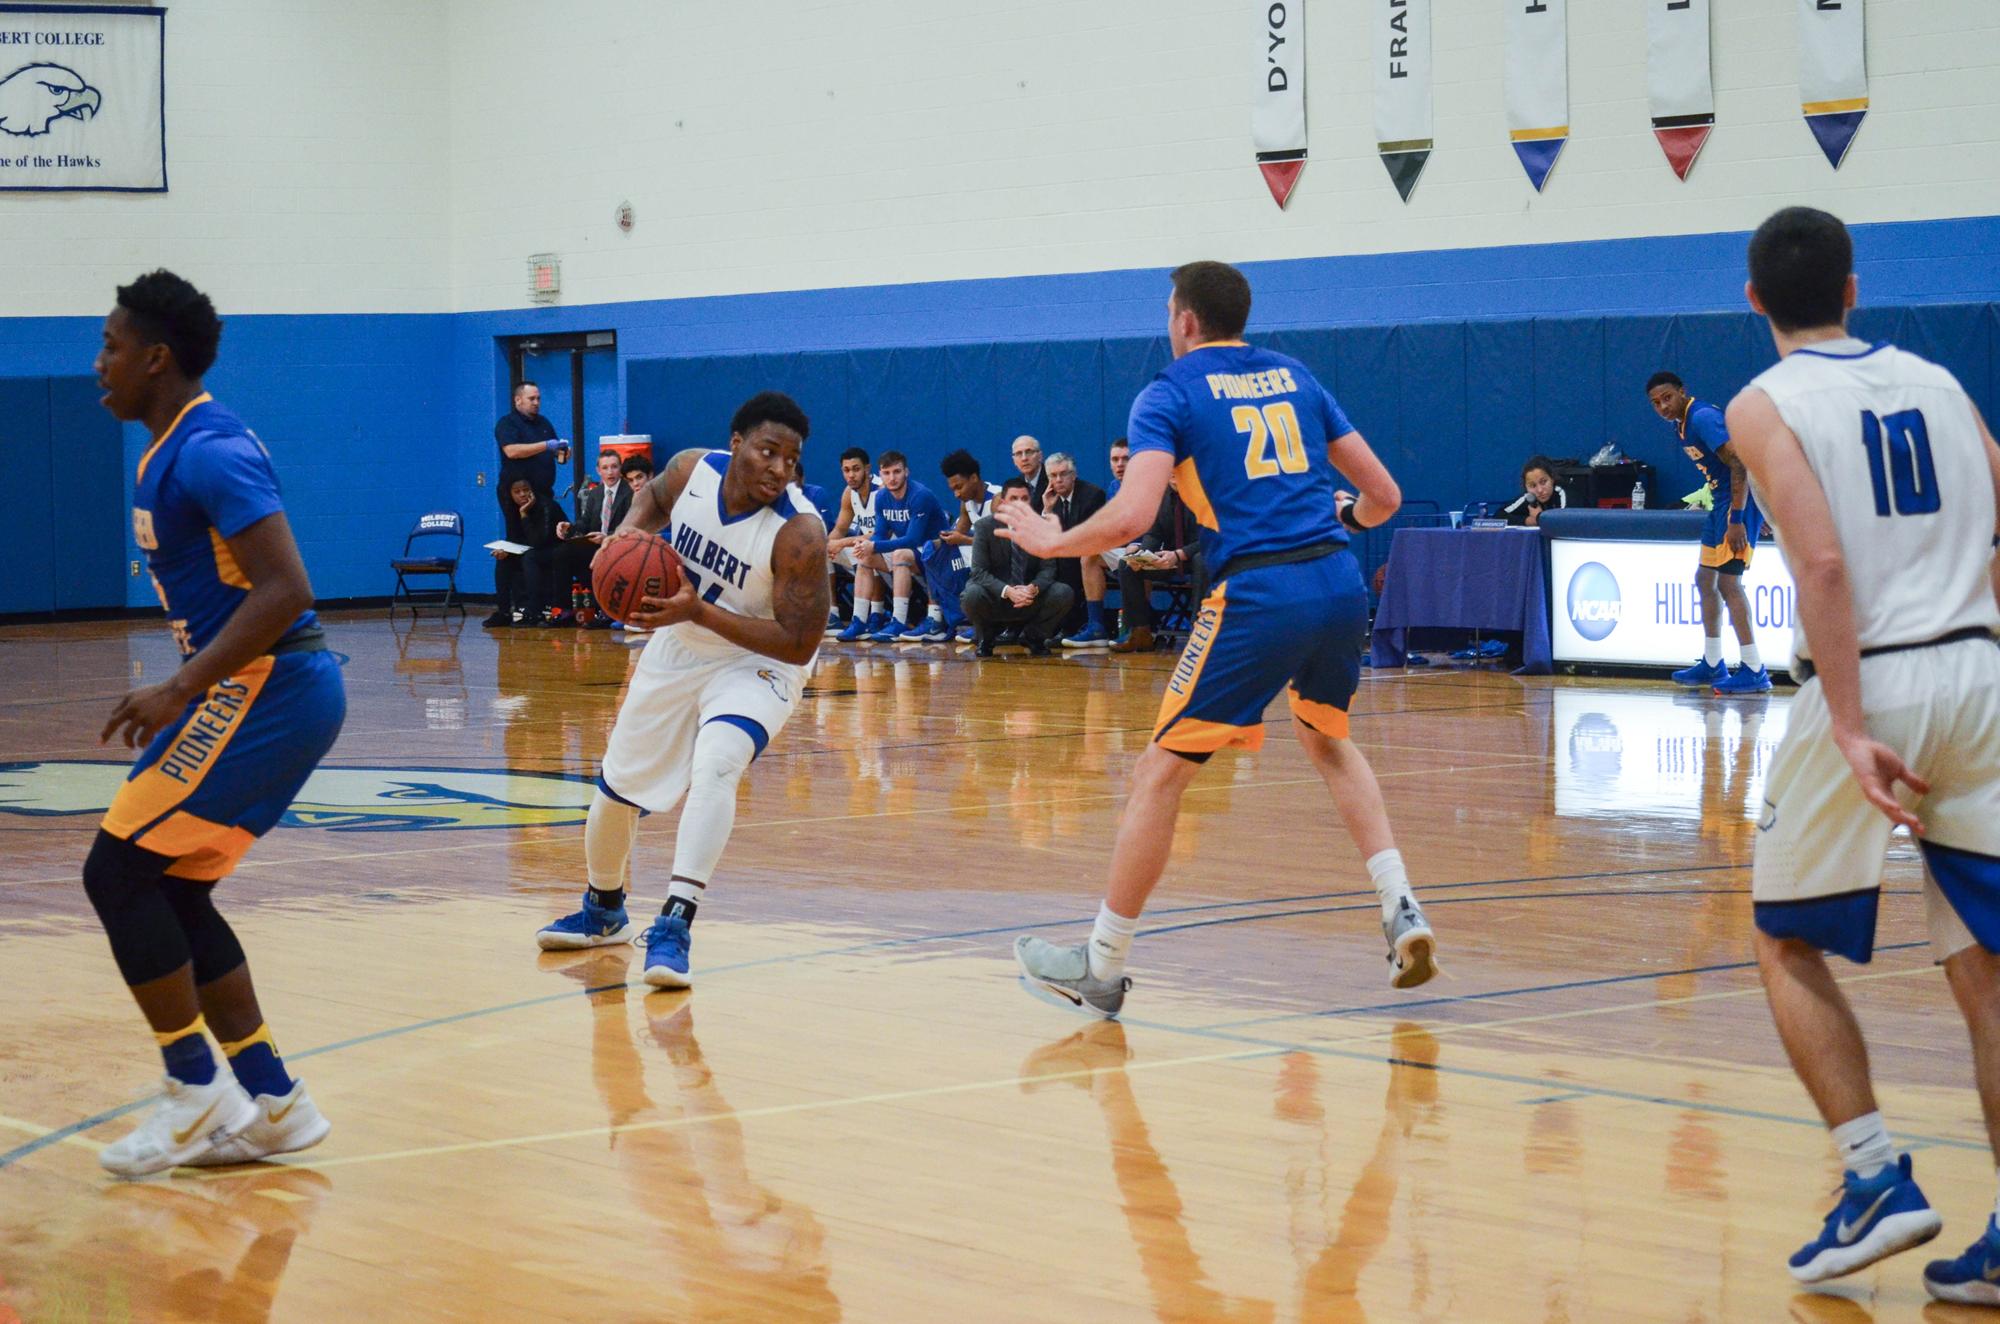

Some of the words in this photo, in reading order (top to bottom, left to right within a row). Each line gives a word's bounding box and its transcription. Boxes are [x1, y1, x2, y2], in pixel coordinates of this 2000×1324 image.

[0, 32, 31, 44] ERT
[35, 31, 105, 45] COLLEGE
[16, 155, 28, 167] of
[33, 155, 52, 167] the
[57, 155, 101, 167] Hawks
[1205, 367, 1298, 400] PIONEERS
[1231, 401, 1310, 480] 20
[1859, 408, 1941, 517] 10
[674, 522, 752, 590] HILBERT
[1572, 599, 1622, 622] NCAA
[1169, 606, 1217, 695] PIONEERS
[160, 677, 249, 784] PIONEERS
